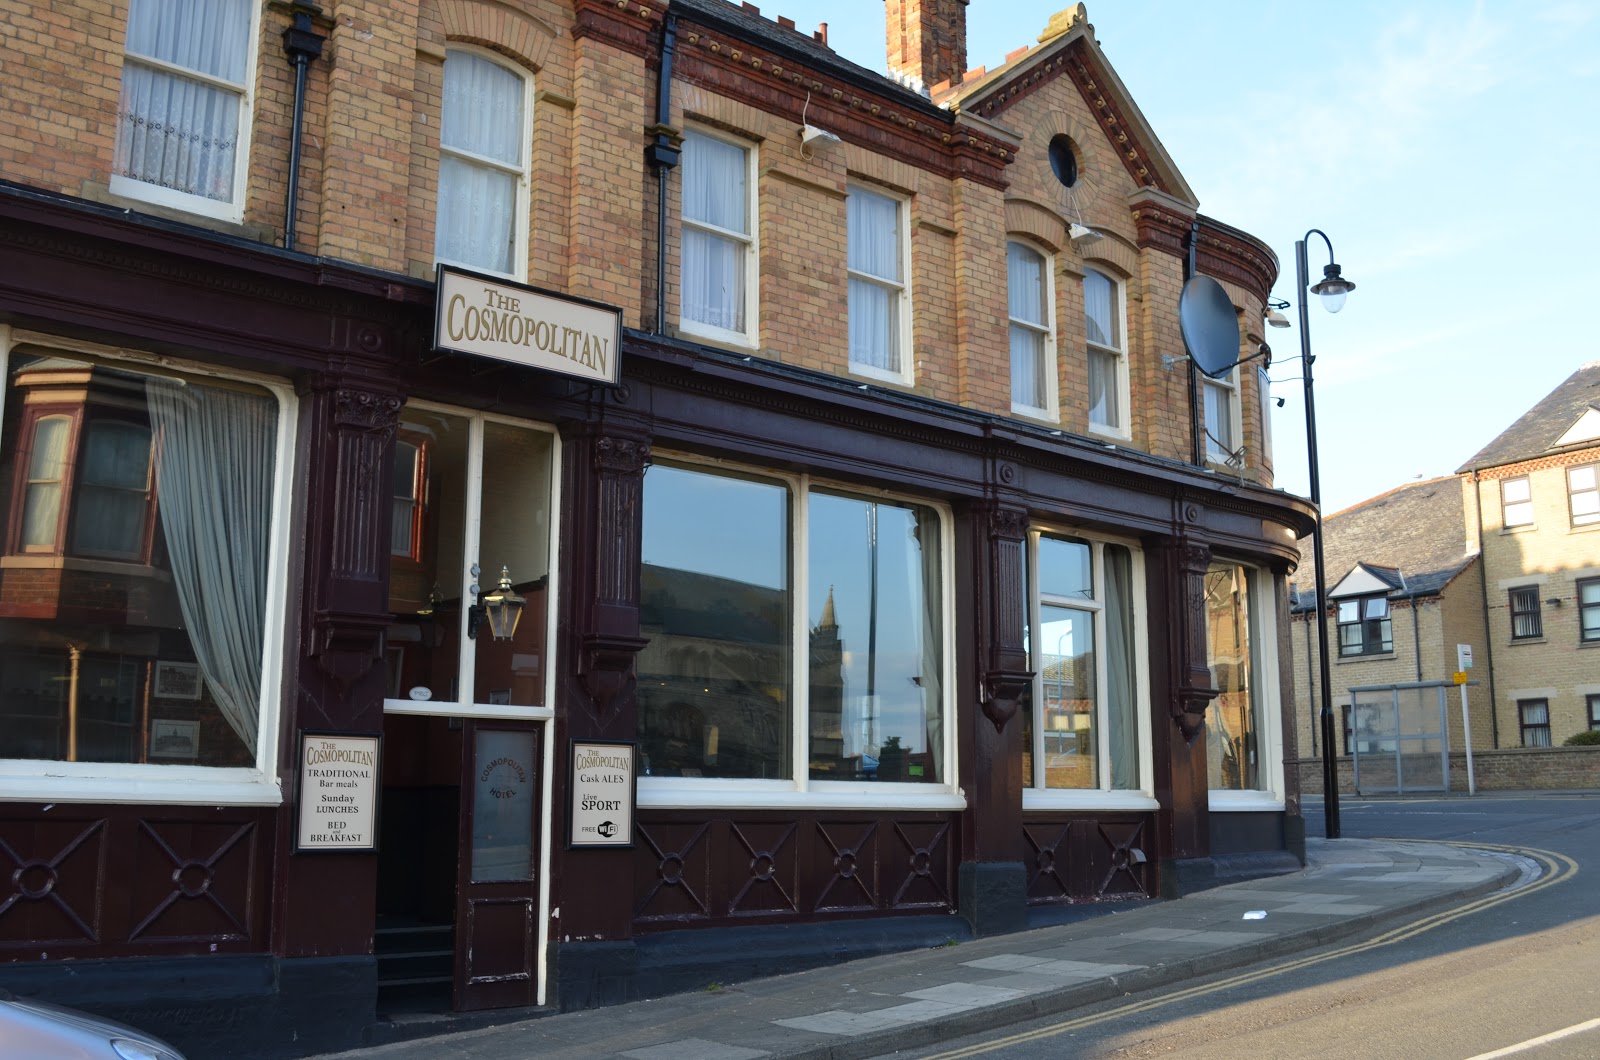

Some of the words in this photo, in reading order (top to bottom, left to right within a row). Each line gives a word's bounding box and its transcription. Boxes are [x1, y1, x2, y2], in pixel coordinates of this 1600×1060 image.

[484, 287, 521, 313] THE
[447, 293, 609, 376] COSMOPOLITAN
[321, 741, 336, 750] THE
[307, 746, 373, 766] COSMOPOLITAN
[576, 753, 629, 771] COSMOPOLITAN
[307, 769, 370, 778] TRADITIONAL
[481, 757, 526, 783] COSMOPOLITAN
[580, 774, 600, 783] Cask
[601, 774, 624, 783] ALES
[319, 780, 333, 788] Bar
[489, 787, 517, 799] HOTEL
[321, 795, 355, 804] Sunday
[316, 806, 359, 814] LUNCHES
[581, 800, 621, 811] SPORT
[327, 821, 347, 829] BED
[310, 834, 362, 842] BREAKFAST
